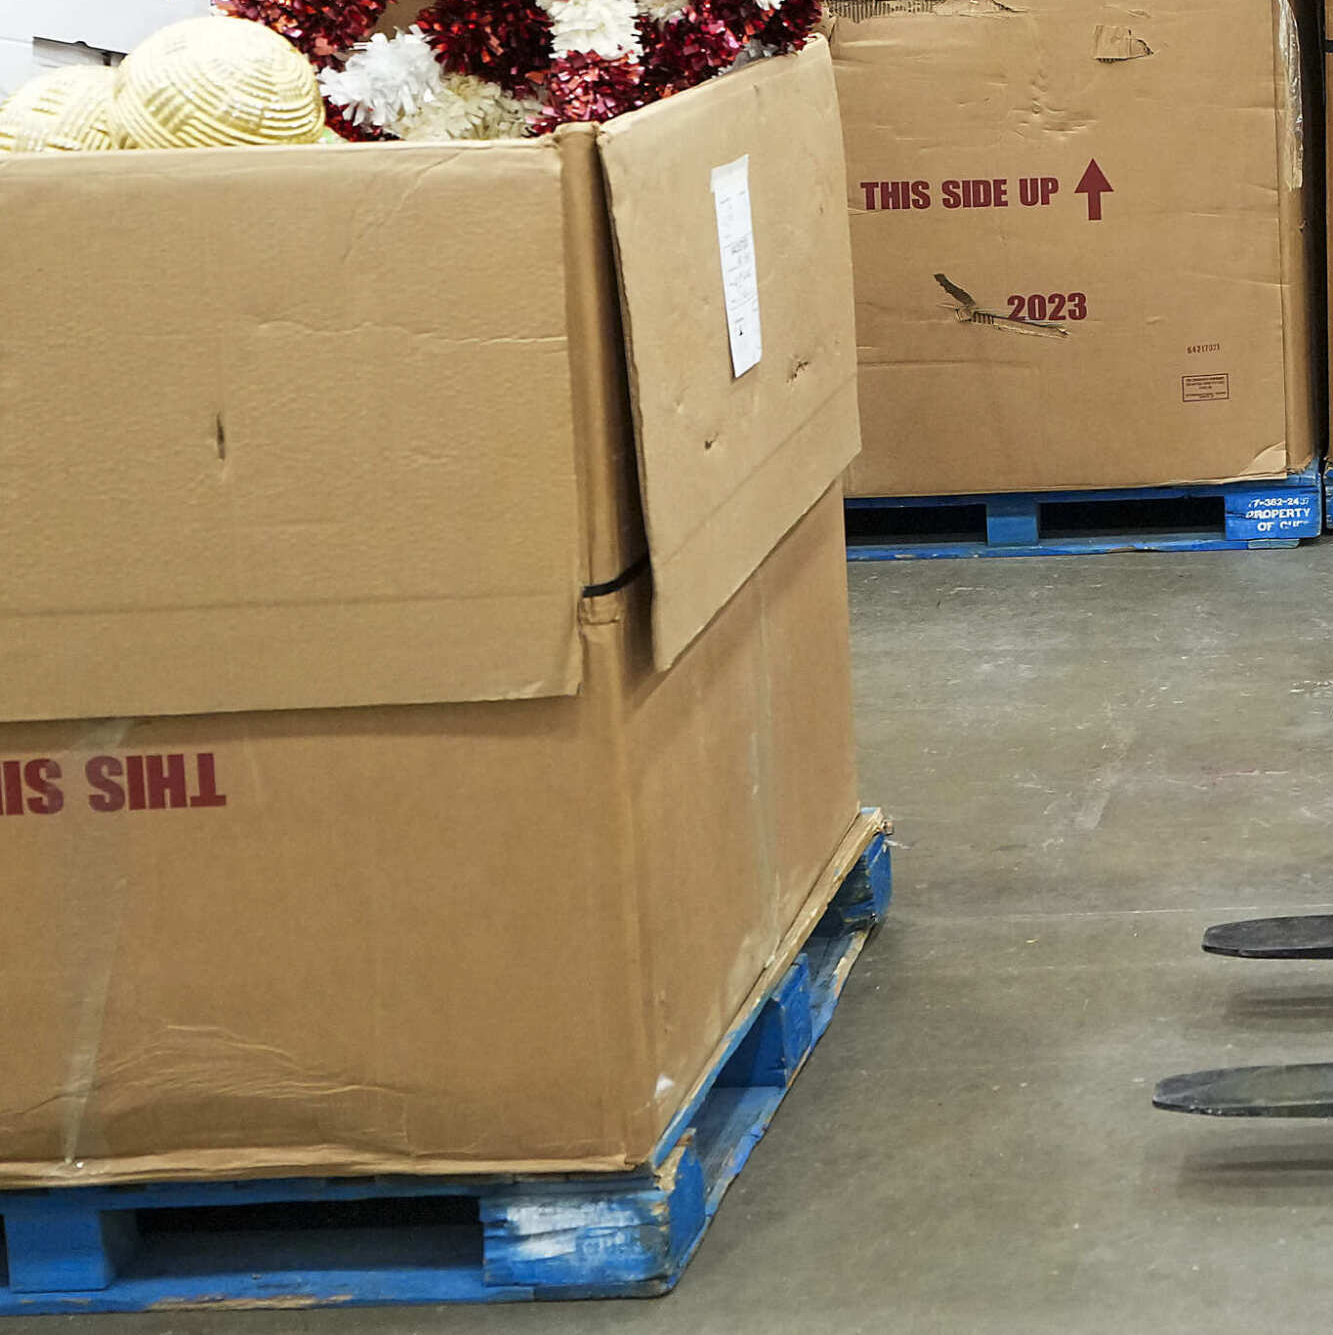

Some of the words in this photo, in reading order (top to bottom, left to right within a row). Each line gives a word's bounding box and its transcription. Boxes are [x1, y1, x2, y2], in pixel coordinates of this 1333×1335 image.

[860, 180, 931, 210] THIS
[941, 178, 1009, 209] SIDE
[1019, 177, 1059, 207] UP
[1007, 292, 1088, 321] 2023
[1245, 508, 1311, 520] PROPERTY
[1257, 521, 1275, 532] OF
[0, 757, 65, 815] SI
[85, 752, 227, 813] THIS
